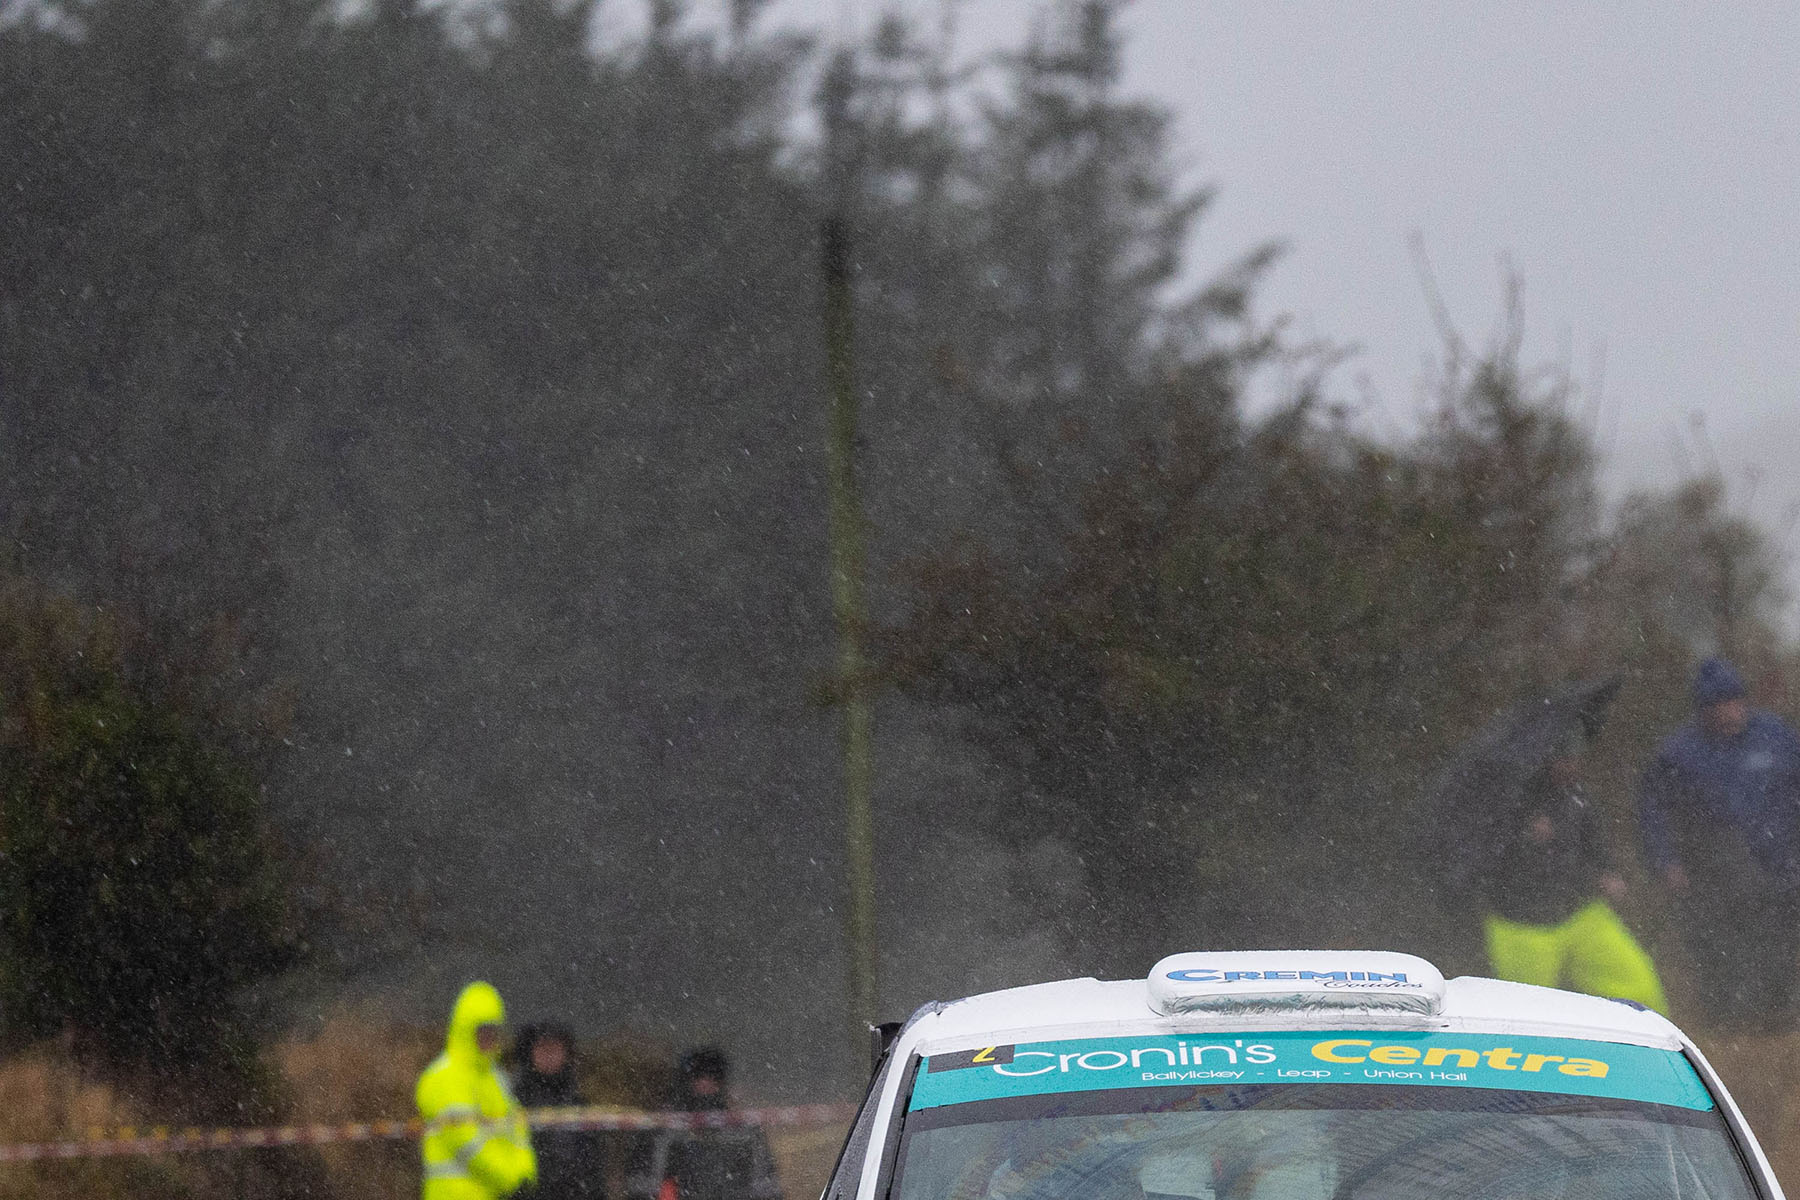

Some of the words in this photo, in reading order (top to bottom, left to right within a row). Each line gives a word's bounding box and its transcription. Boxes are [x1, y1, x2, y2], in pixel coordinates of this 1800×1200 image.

[1166, 969, 1408, 983] CREMIN
[993, 1039, 1277, 1077] Cronin's
[1311, 1039, 1610, 1078] Centra
[1142, 1069, 1245, 1082] Ballylickey
[1277, 1068, 1331, 1080] Leap
[1365, 1069, 1422, 1080] Union
[1430, 1070, 1467, 1082] Hall
